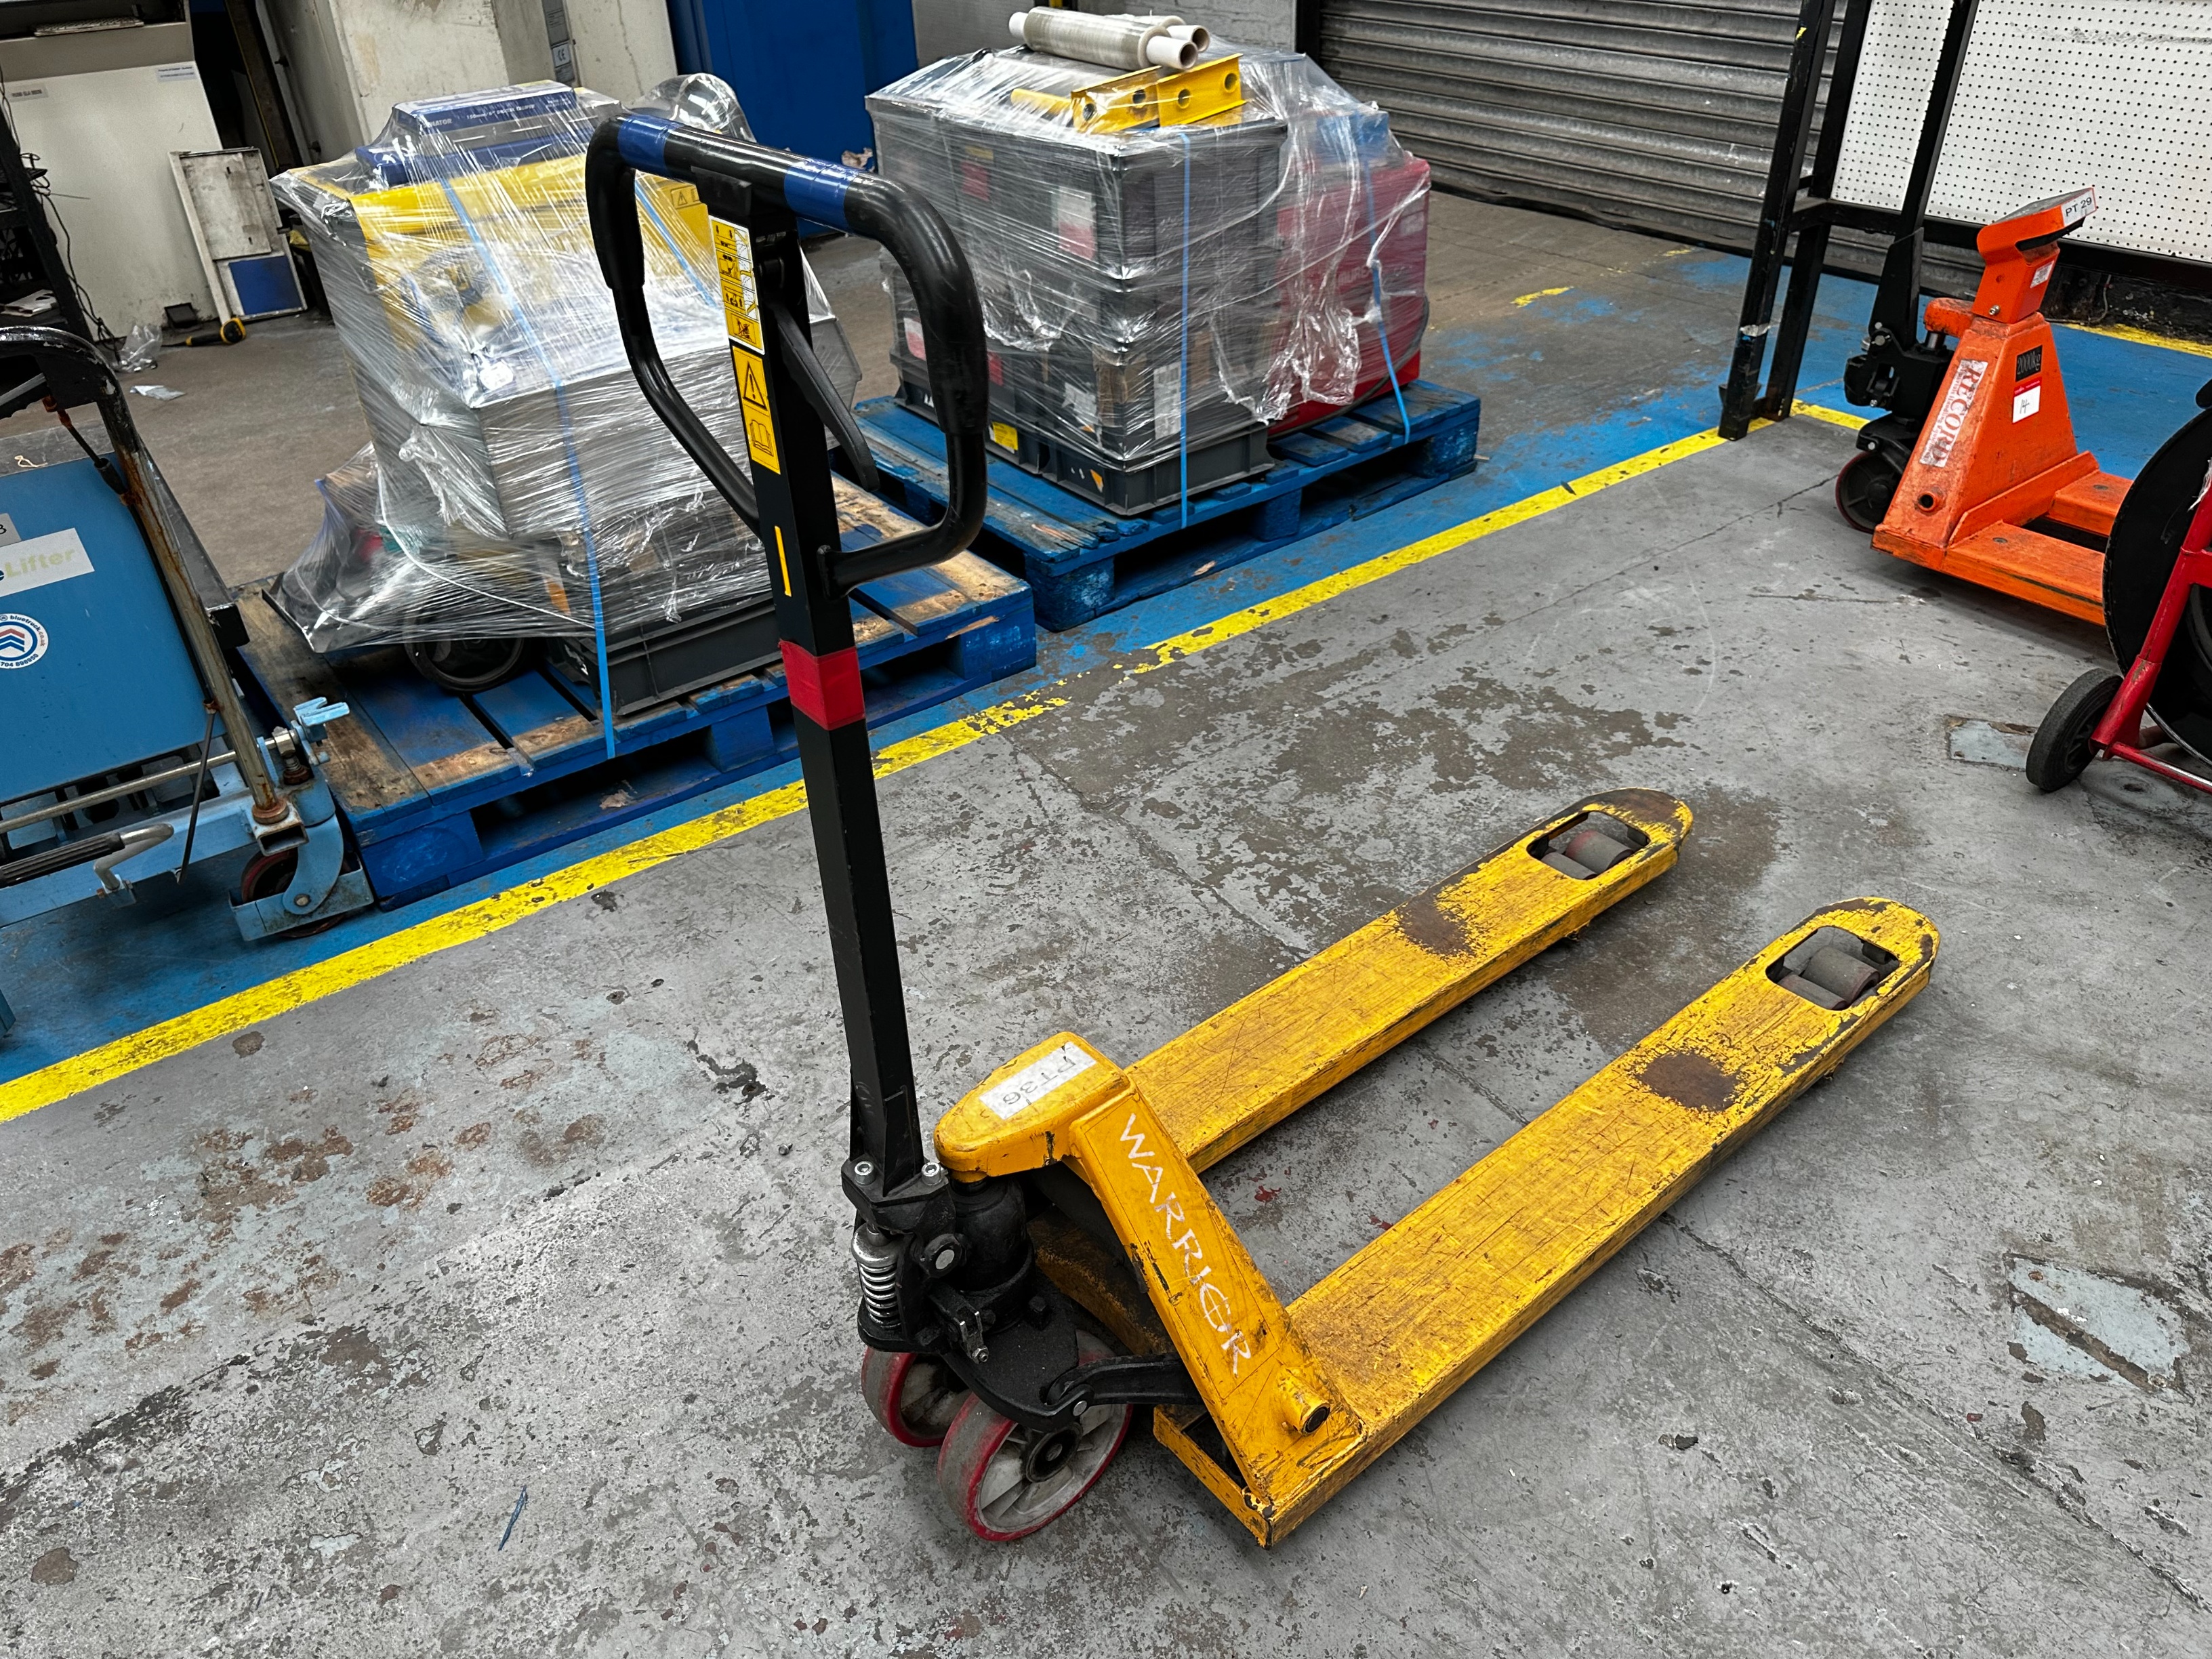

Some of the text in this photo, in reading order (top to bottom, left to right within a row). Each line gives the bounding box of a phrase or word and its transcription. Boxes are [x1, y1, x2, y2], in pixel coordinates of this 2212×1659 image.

[2065, 197, 2093, 217] PT 29
[2017, 351, 2041, 374] 2000kg
[1931, 367, 1983, 462] RECORD
